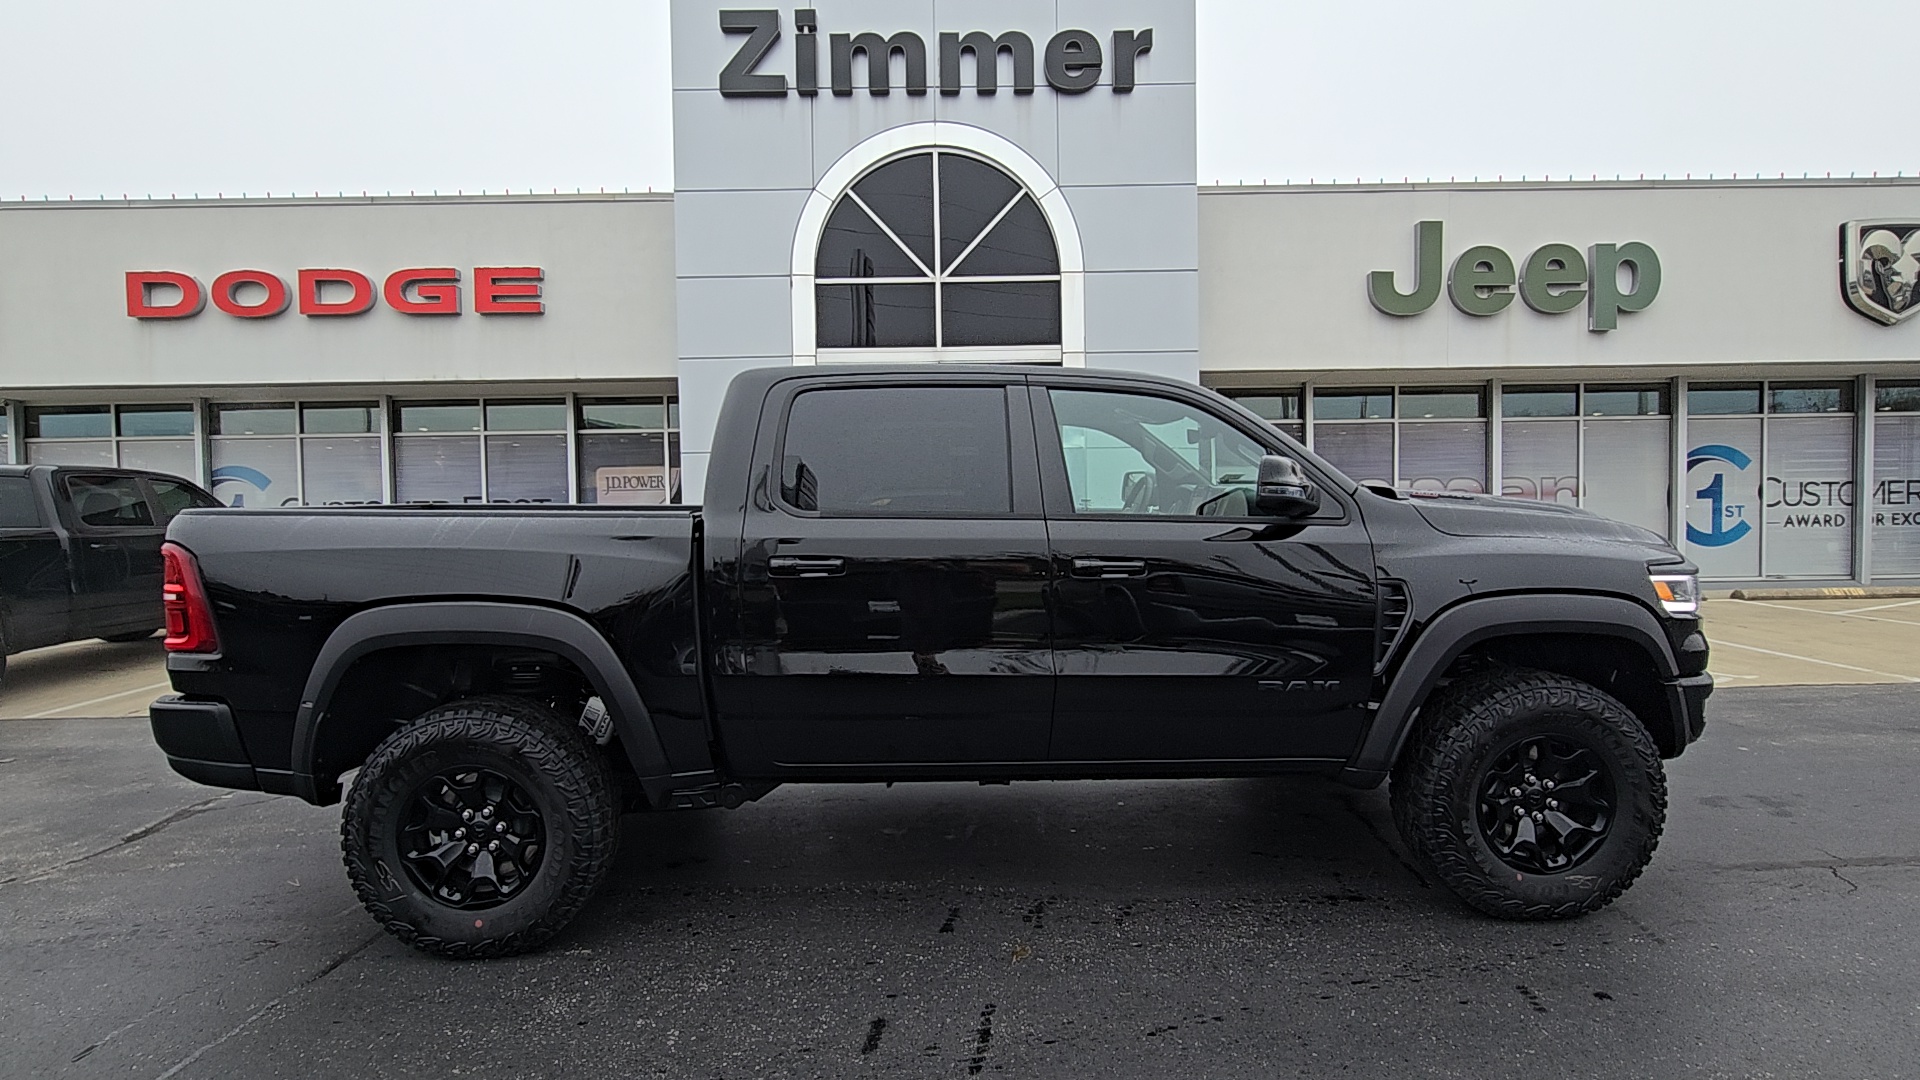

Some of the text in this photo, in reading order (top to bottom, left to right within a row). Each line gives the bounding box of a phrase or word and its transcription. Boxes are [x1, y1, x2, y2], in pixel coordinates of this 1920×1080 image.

[719, 9, 1153, 97] Zimmer
[125, 266, 545, 318] DODGE
[1366, 220, 1662, 332] Jeep
[1783, 514, 1845, 528] AWARD
